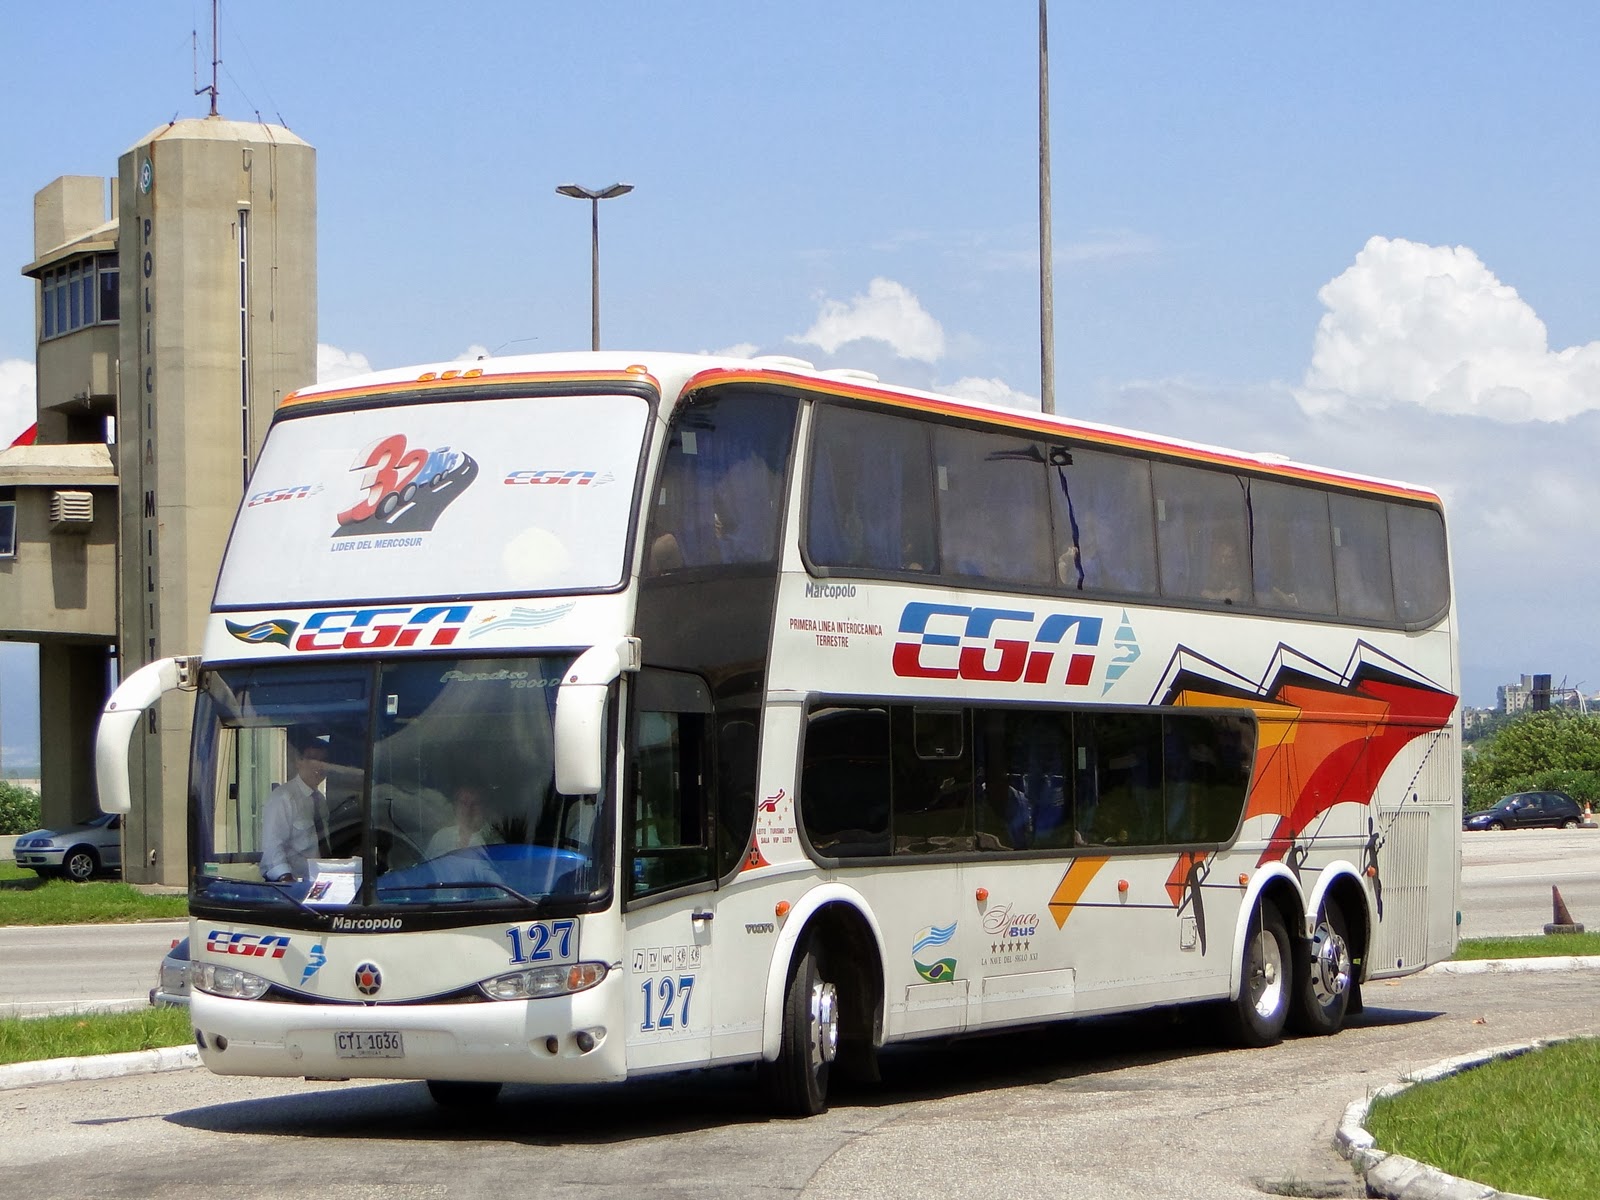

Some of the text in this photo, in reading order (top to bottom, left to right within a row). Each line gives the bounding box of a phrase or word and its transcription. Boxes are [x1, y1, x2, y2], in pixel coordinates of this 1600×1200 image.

[143, 218, 157, 734] POLÍCIA MILITR
[337, 433, 429, 527] 32
[331, 537, 423, 552] LIDER DEL MERCOSUR
[805, 582, 857, 599] Marcopolo
[295, 605, 474, 651] EGA
[789, 618, 883, 636] PRIMERA LINEA INTEROCEANICA
[815, 634, 849, 648] TERRESTRE
[892, 601, 1104, 686] EGA
[439, 669, 529, 683] Paradiso
[332, 916, 403, 931] Marcopolo
[744, 922, 774, 934] VOLVO
[983, 902, 1039, 938] Space
[206, 930, 291, 959] EGA
[506, 920, 575, 965] 127
[649, 953, 657, 963] TV
[662, 954, 673, 964] WC
[981, 958, 987, 966] LA
[1003, 956, 1012, 964] DEL
[1014, 954, 1028, 963] SIGLO
[641, 974, 696, 1033] 127
[338, 1034, 399, 1050] CTI 1036
